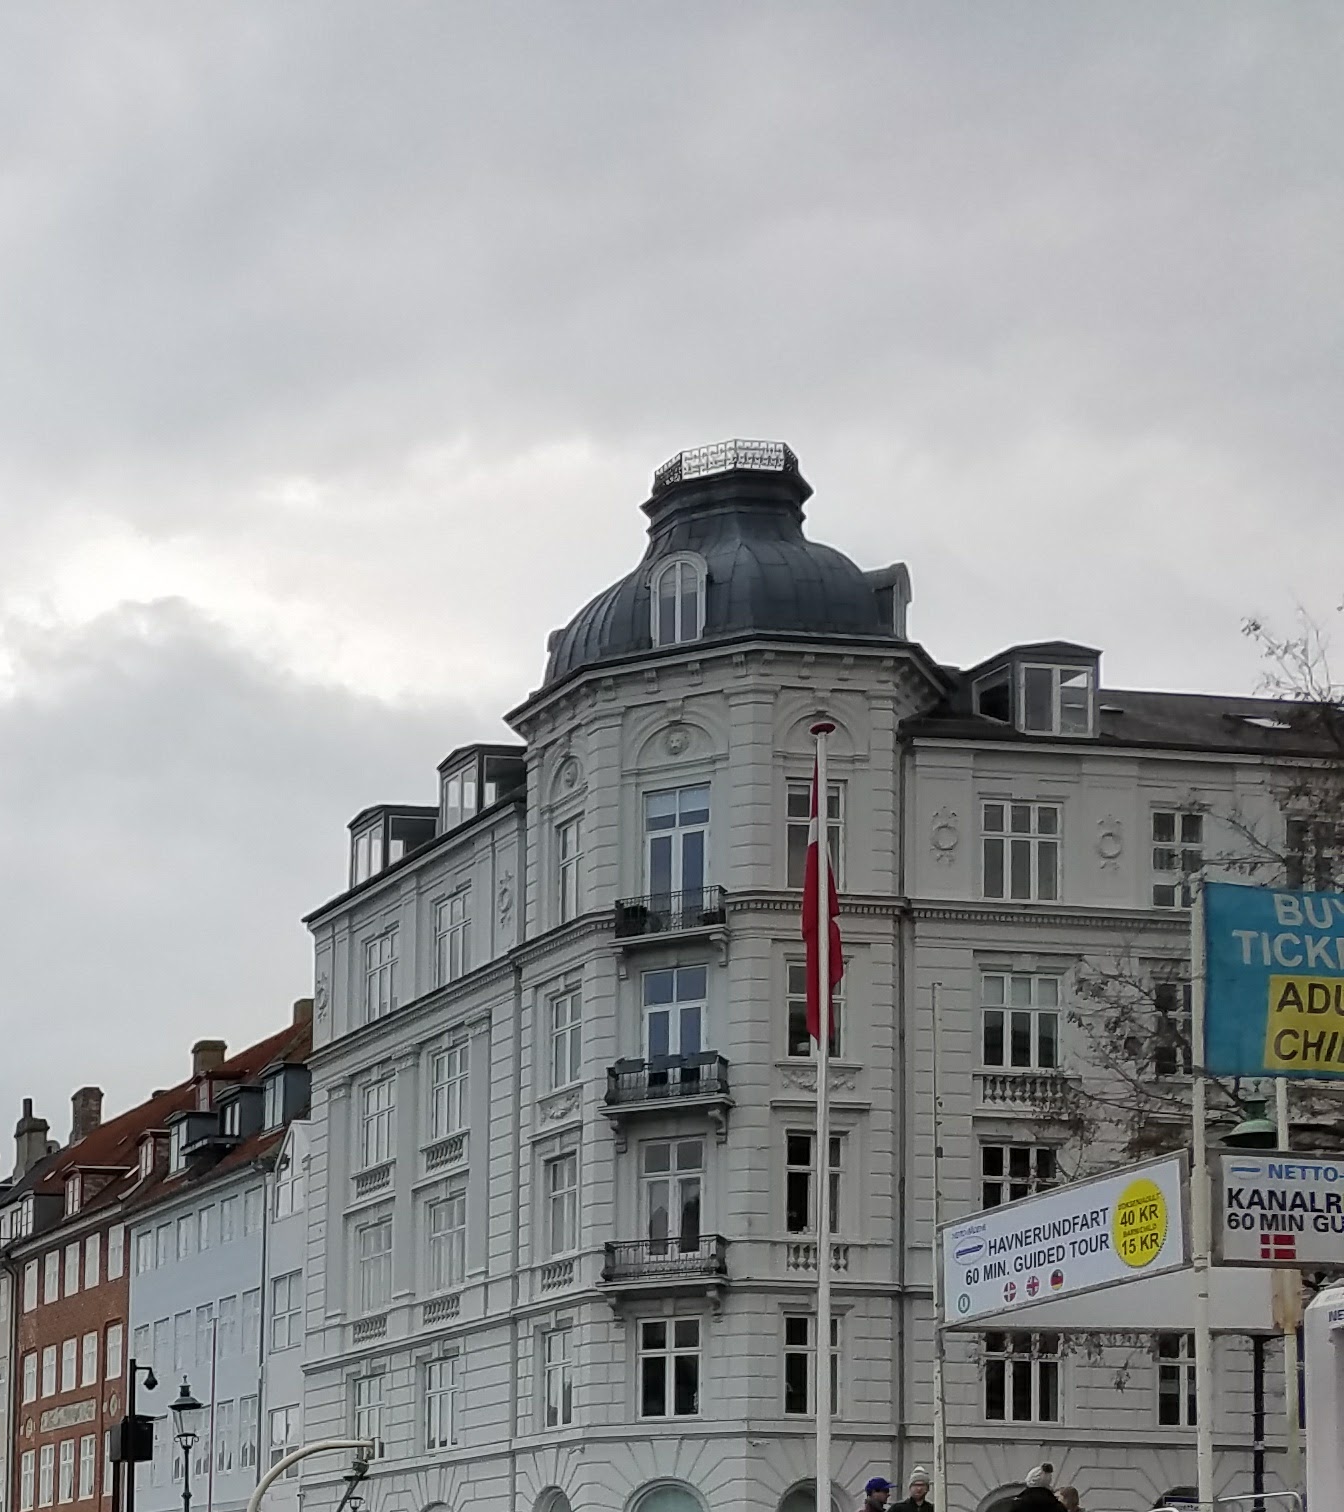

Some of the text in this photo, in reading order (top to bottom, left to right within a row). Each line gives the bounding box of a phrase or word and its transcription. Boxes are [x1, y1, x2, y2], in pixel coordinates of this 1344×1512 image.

[1120, 1204, 1159, 1227] 40 KR
[1227, 1212, 1254, 1230] 60
[1260, 1213, 1304, 1231] MIN
[988, 1207, 1109, 1256] HAVNERUNDFART
[1121, 1232, 1160, 1256] 15 KR
[966, 1268, 979, 1286] 60
[1014, 1244, 1065, 1273] GUIDED
[1069, 1233, 1110, 1258] TOUR
